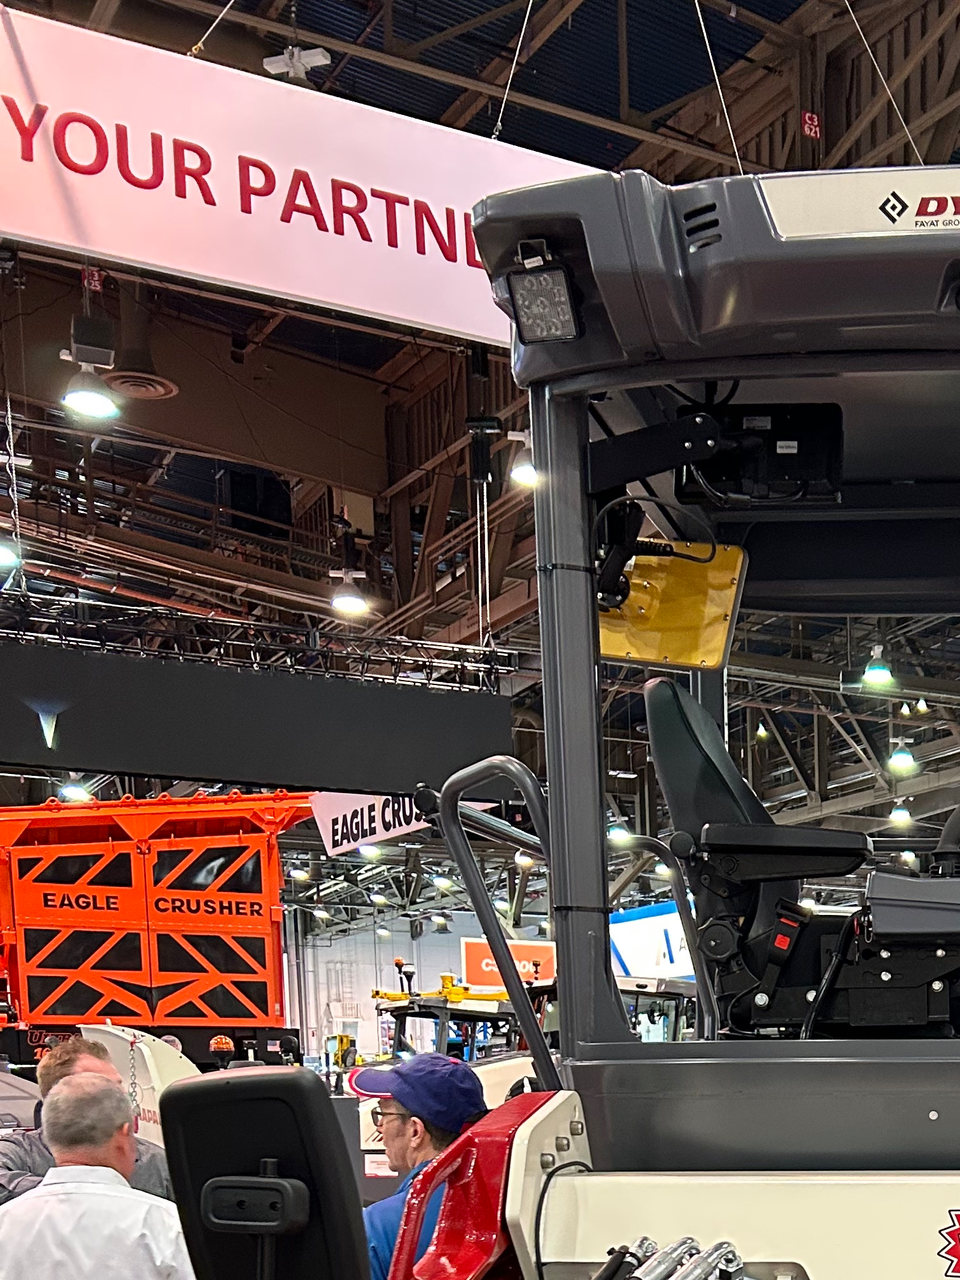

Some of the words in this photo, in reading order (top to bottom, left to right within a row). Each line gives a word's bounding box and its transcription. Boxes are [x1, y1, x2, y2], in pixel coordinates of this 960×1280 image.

[805, 112, 818, 126] C3
[804, 124, 820, 139] 621
[0, 94, 217, 207] YOUR
[914, 219, 940, 228] FAYAT
[331, 803, 377, 849] EAGLE
[42, 892, 120, 912] EAGLE
[154, 896, 264, 918] CRUSHER
